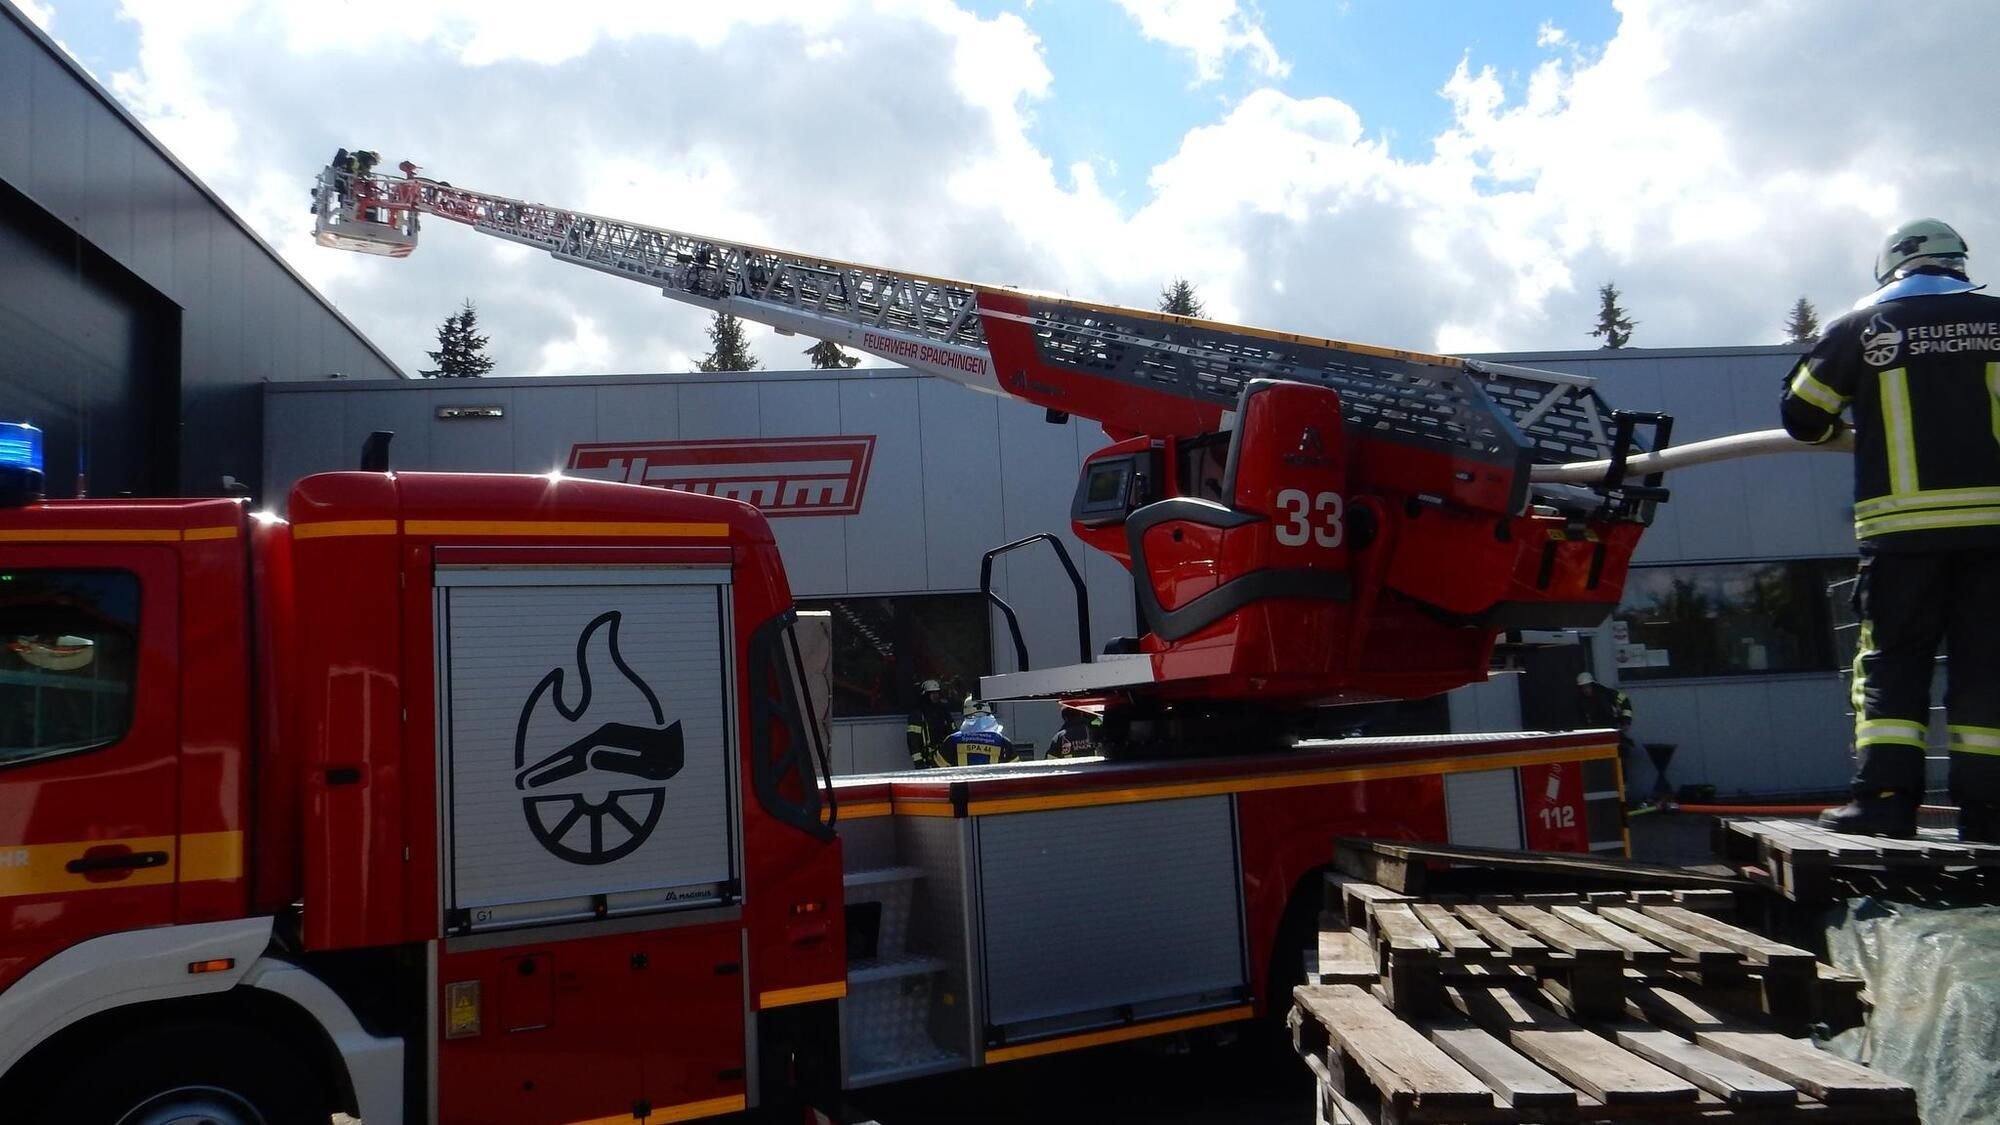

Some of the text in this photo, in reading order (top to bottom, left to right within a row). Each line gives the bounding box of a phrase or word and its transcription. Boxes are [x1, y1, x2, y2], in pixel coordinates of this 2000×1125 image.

[1907, 322, 2000, 340] FEUERWE
[863, 333, 987, 375] FEUERWEHR SPAICHINGEN
[1275, 488, 1343, 548] 33
[1540, 805, 1575, 829] 112
[476, 909, 493, 921] G1
